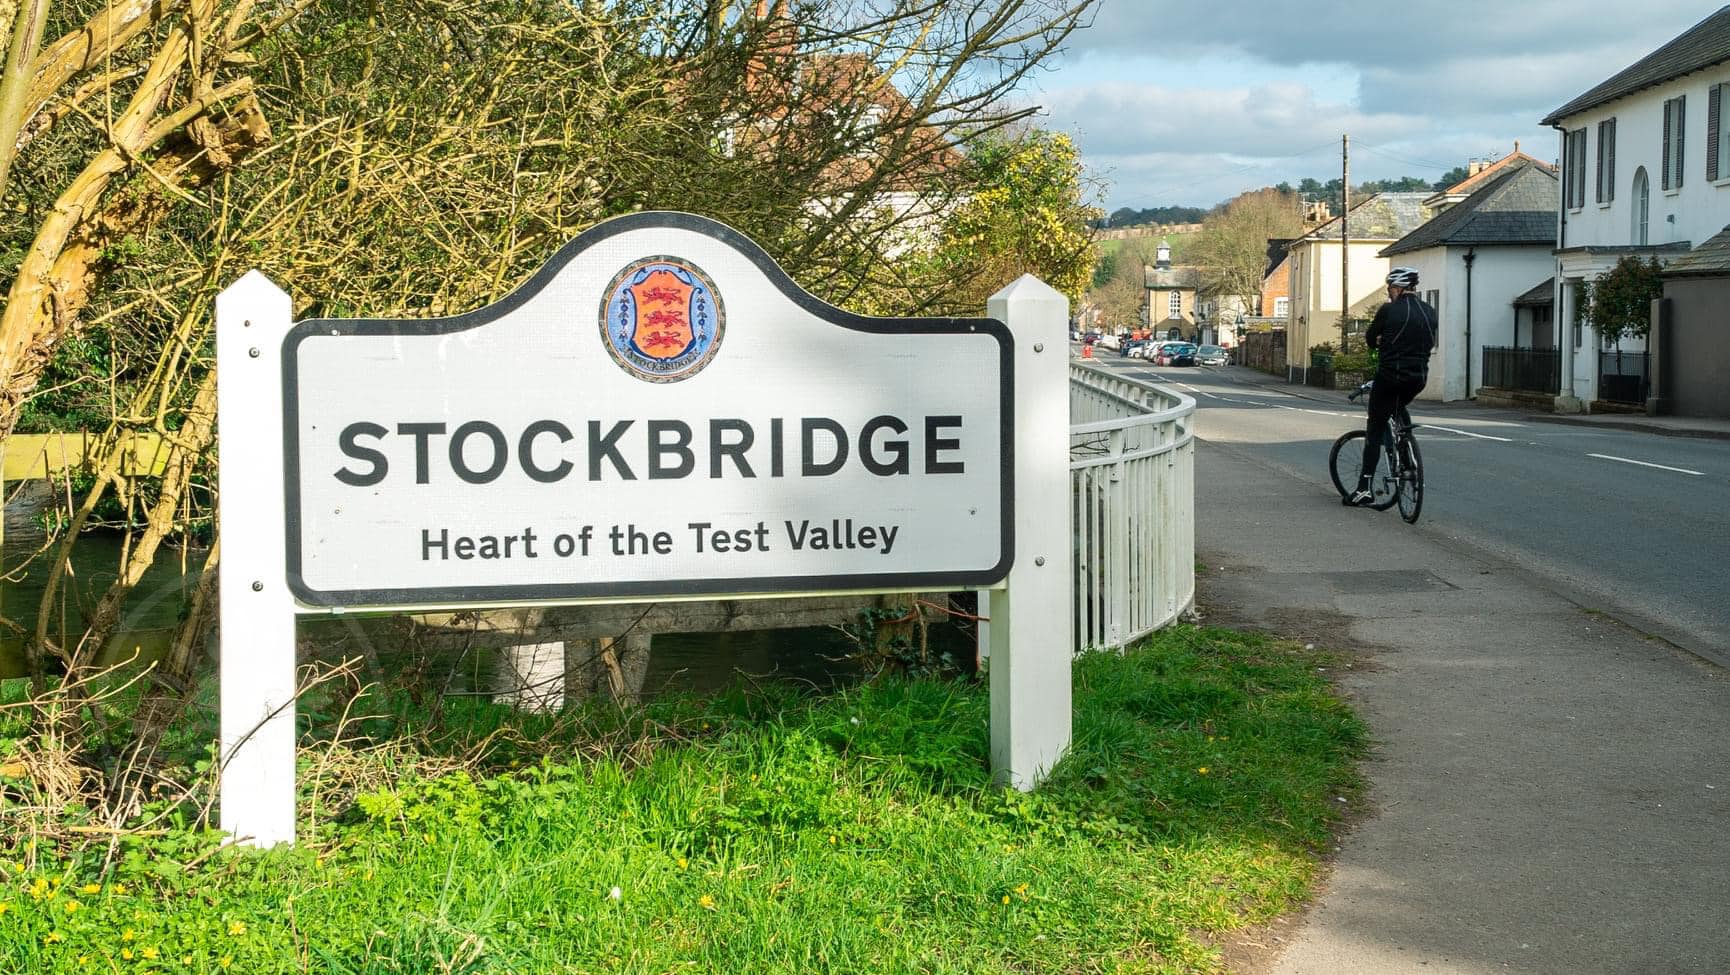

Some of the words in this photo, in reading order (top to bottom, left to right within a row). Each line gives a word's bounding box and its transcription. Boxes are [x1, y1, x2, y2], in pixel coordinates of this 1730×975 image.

[334, 415, 965, 486] STOCKBRIDGE
[422, 528, 537, 560] Heart
[554, 526, 593, 557] of
[609, 525, 672, 555] the
[688, 522, 769, 552] Test
[785, 519, 898, 554] Valley
